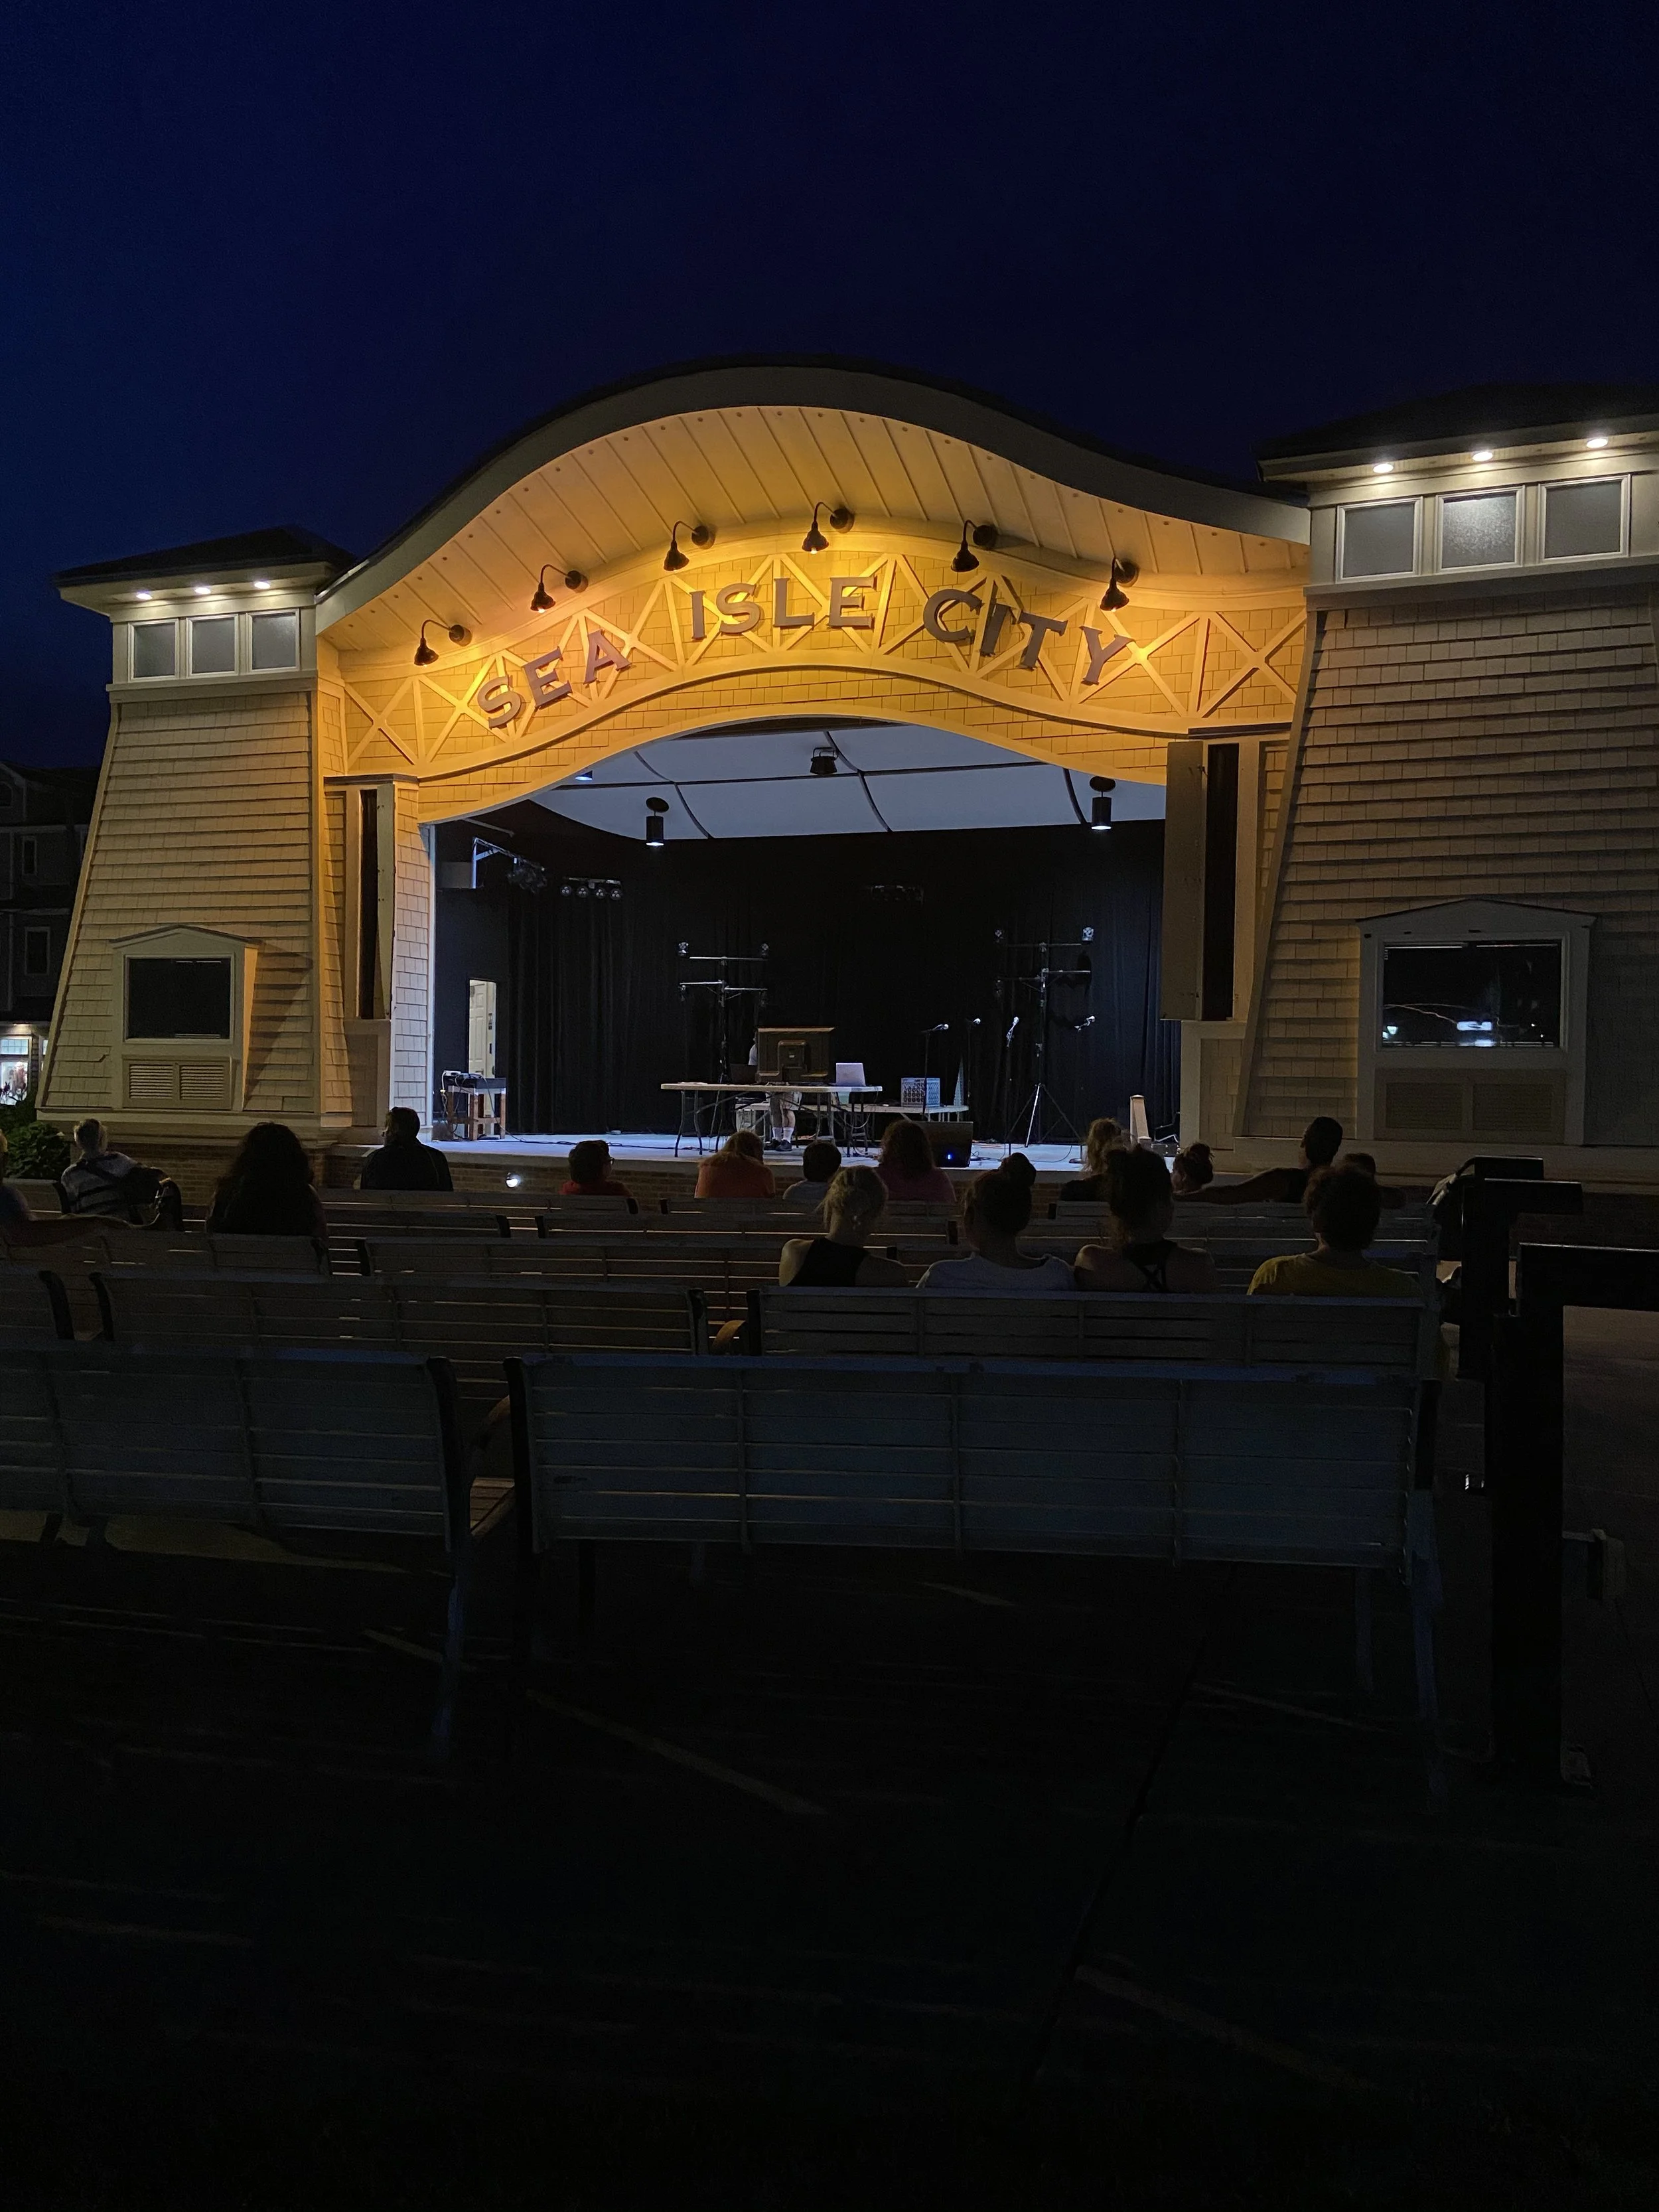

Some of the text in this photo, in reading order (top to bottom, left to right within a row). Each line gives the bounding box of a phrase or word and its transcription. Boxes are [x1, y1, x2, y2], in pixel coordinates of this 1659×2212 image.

[476, 576, 1135, 729] SEA ISLE CITY
